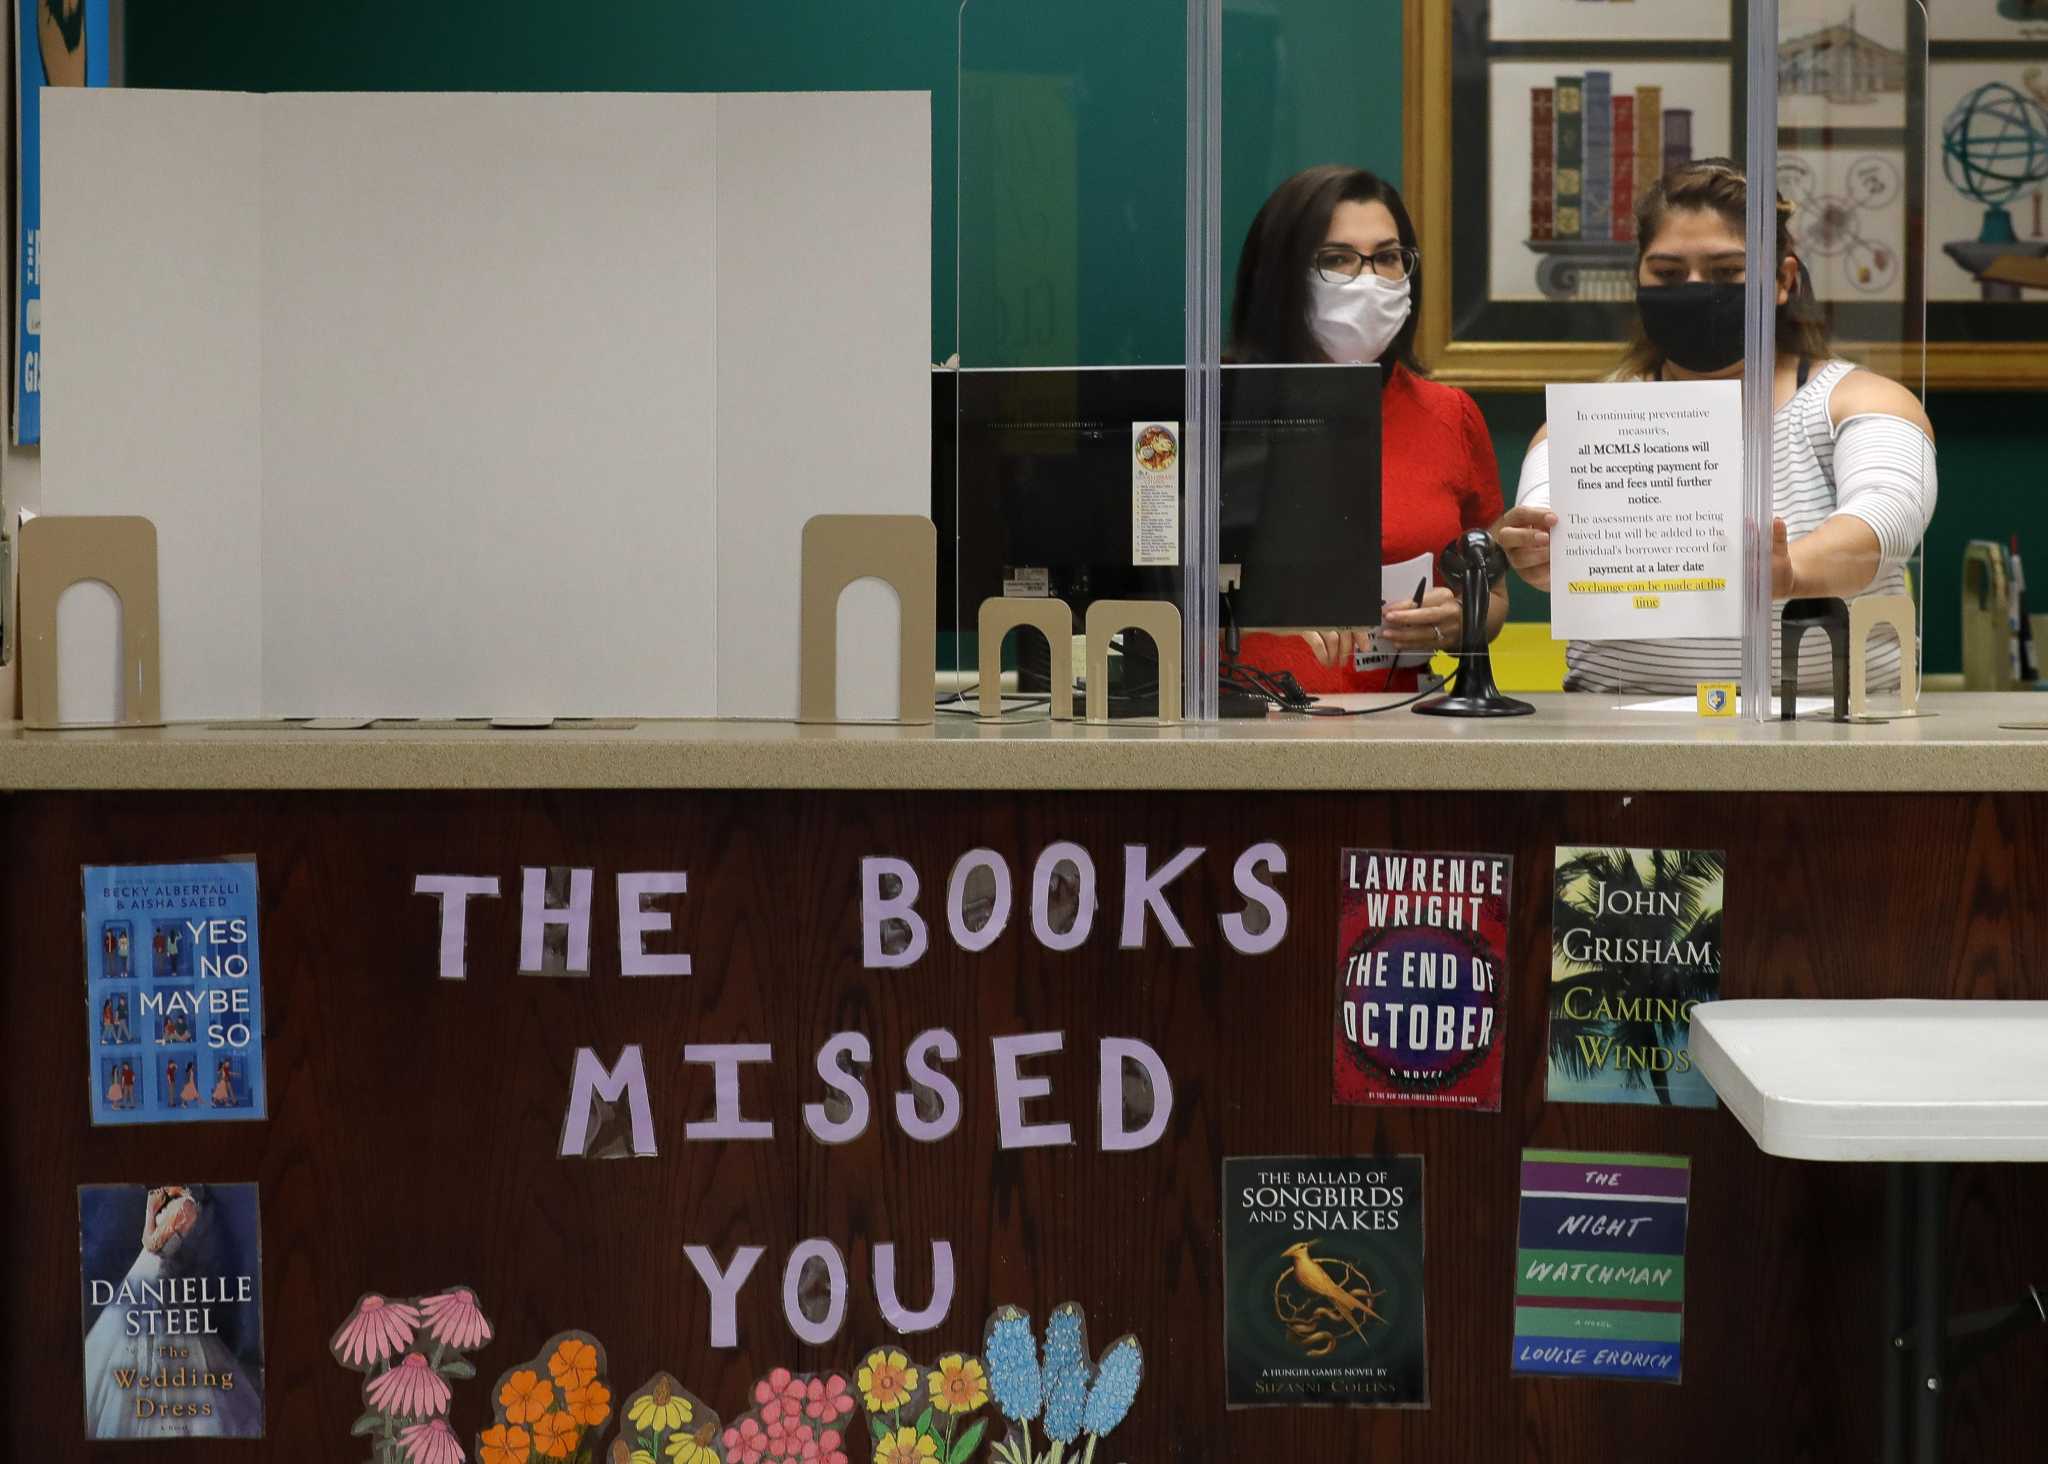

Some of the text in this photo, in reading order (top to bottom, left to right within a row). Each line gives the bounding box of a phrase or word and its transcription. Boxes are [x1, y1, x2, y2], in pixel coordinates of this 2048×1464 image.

[1577, 408, 1709, 423] In continuing preventative
[1618, 426, 1669, 436] measures,
[1579, 442, 1709, 455] all MCMLS locations will
[1570, 460, 1718, 475] not be accepting payment for
[1577, 477, 1712, 490] fines and fees until further
[1628, 494, 1661, 504] notice.
[1568, 512, 1724, 524] The assessments are not being
[1567, 526, 1724, 540] waived but will be added to the
[1625, 543, 1671, 554] borrower
[1675, 542, 1708, 553] record
[1712, 541, 1727, 552] for
[1589, 560, 1704, 576] payment at a later date
[1569, 579, 1725, 594] No change can be made at this
[1636, 598, 1659, 608] time
[1350, 855, 1503, 895] LAWRENCE
[103, 884, 239, 898] BECKY ALBERTALLI
[1596, 881, 1681, 919] JOHN
[117, 898, 226, 910] & AISHA SAEED
[414, 842, 1289, 978] THE BOOKS
[1367, 894, 1482, 931] WRIGHT
[187, 920, 247, 945] YES
[1562, 928, 1712, 966] GRISHAM
[201, 955, 247, 979] NO
[1346, 952, 1493, 992] THE END OF
[140, 989, 250, 1015] MAYBE
[208, 1024, 250, 1048] SO
[1344, 1001, 1493, 1050] OCTOBER
[1576, 1035, 1691, 1074] WINDS
[561, 1029, 1173, 1156] MISSED
[1258, 1172, 1387, 1184] THE BALLAD OF
[1585, 1171, 1621, 1186] THE
[1242, 1187, 1403, 1208] SONGBIRDS
[1249, 1210, 1399, 1230] AND SNAKES
[1557, 1215, 1652, 1237] NIGHT
[1525, 1259, 1672, 1287] WATCHMAN
[91, 1276, 252, 1306] DANIELLE
[684, 1240, 955, 1347] YOU
[126, 1309, 218, 1336] STEEL
[1520, 1346, 1672, 1369] LOUISE ERDRICH
[113, 1368, 234, 1389] Wedding
[1270, 1368, 1309, 1377] HUNGER
[1311, 1368, 1342, 1376] GAMES
[1344, 1368, 1373, 1376] NOVEL
[1377, 1368, 1387, 1376] BY
[136, 1399, 213, 1419] Dress
